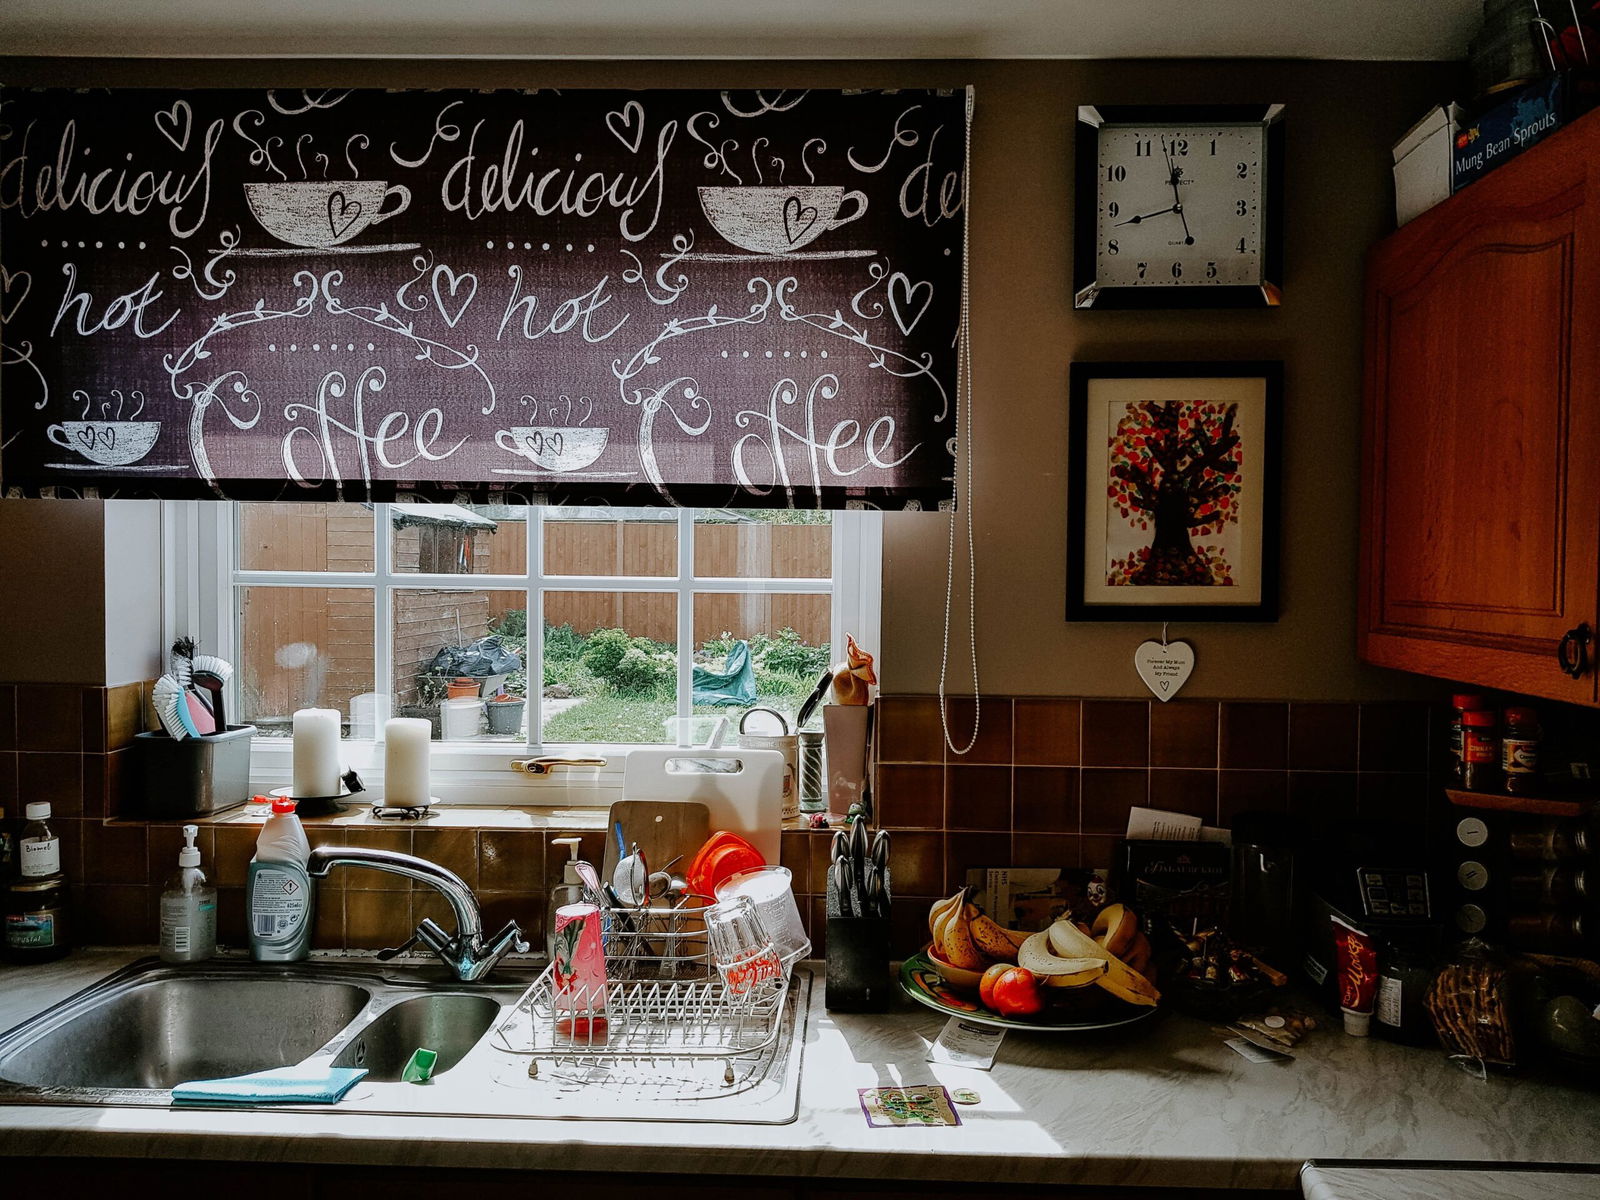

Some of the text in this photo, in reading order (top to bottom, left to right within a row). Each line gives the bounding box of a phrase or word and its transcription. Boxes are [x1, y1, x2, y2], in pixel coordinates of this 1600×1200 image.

[1135, 140, 1151, 156] 11
[1169, 140, 1188, 156] 12
[1209, 139, 1216, 156] 1
[1455, 112, 1557, 175] Mung Bean Sprouts
[0, 118, 224, 239] delicious
[1106, 165, 1126, 182] 10
[1236, 162, 1247, 179] 2
[442, 119, 677, 241] delicious
[1109, 202, 1119, 218] 9
[1236, 200, 1247, 216] 3
[1108, 239, 1119, 255] 8
[1236, 238, 1247, 254] 4
[1137, 262, 1147, 278] 7
[1171, 262, 1182, 278] 6
[1206, 262, 1217, 278] 5
[50, 262, 181, 339] hot
[497, 265, 631, 343] hot
